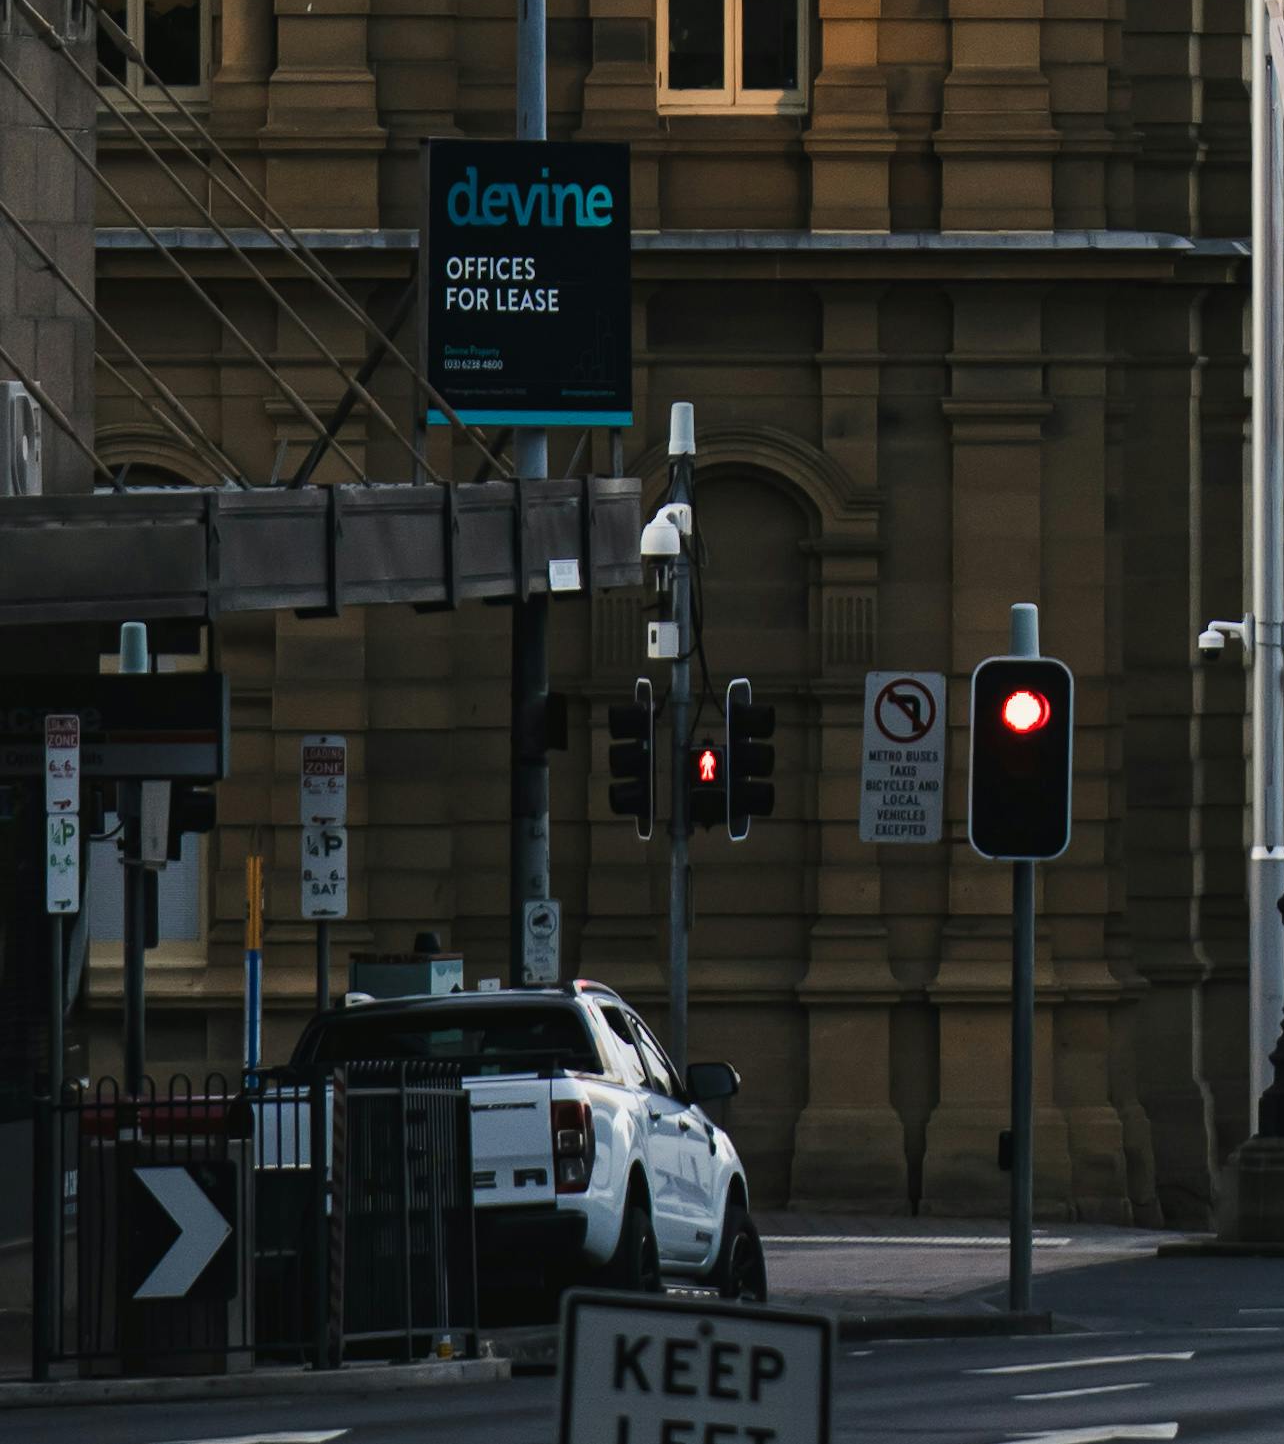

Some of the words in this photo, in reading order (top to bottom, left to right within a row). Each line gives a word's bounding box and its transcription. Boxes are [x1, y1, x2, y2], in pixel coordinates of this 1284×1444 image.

[446, 165, 614, 228] devine
[445, 255, 536, 281] OFFICES
[445, 286, 489, 311] FOR
[496, 287, 560, 312] LEASE
[48, 733, 79, 747] ZONE
[868, 750, 902, 761] METRO
[905, 751, 939, 762] BUSES
[305, 762, 344, 774] ZONE
[889, 765, 917, 776] TAXIS
[865, 780, 915, 791] BICYCLES
[918, 781, 940, 792] AND
[882, 794, 921, 805] LOCAL
[876, 809, 927, 821] VEHICLES
[875, 824, 927, 836] EXCEPTED
[311, 883, 338, 896] SAT
[612, 1333, 785, 1402] KEEP
